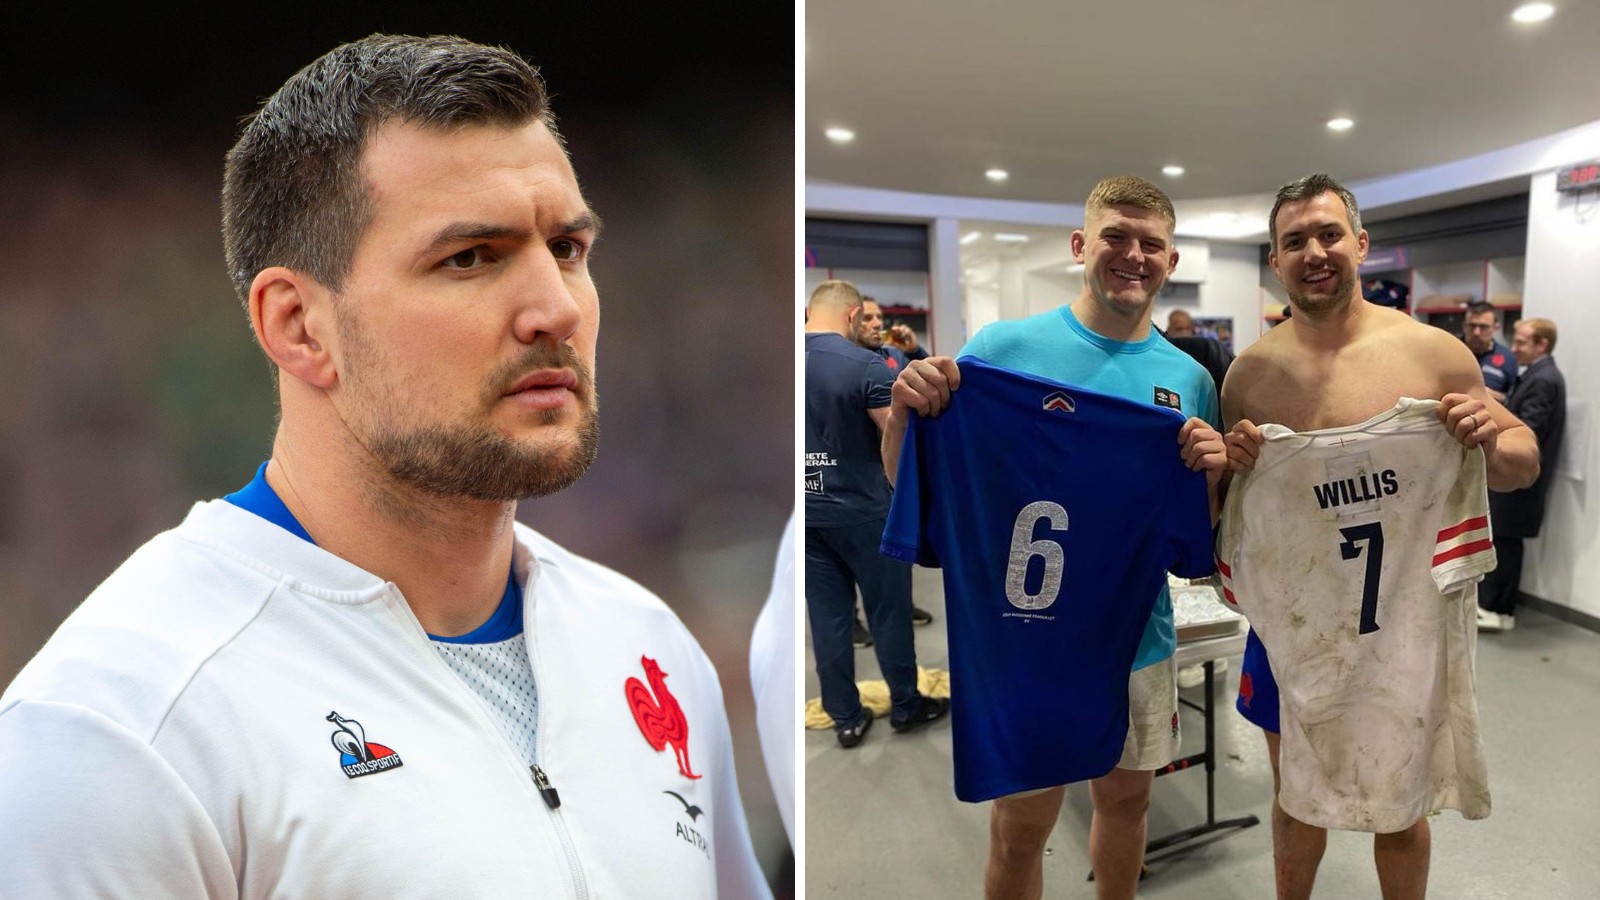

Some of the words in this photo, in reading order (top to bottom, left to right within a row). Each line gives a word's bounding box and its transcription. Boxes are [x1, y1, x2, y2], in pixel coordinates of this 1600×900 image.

[1313, 469, 1399, 509] WILLIS
[1005, 500, 1069, 610] 6
[1339, 521, 1384, 635] 7
[352, 762, 369, 774] COQ
[367, 753, 400, 771] SPORTIF
